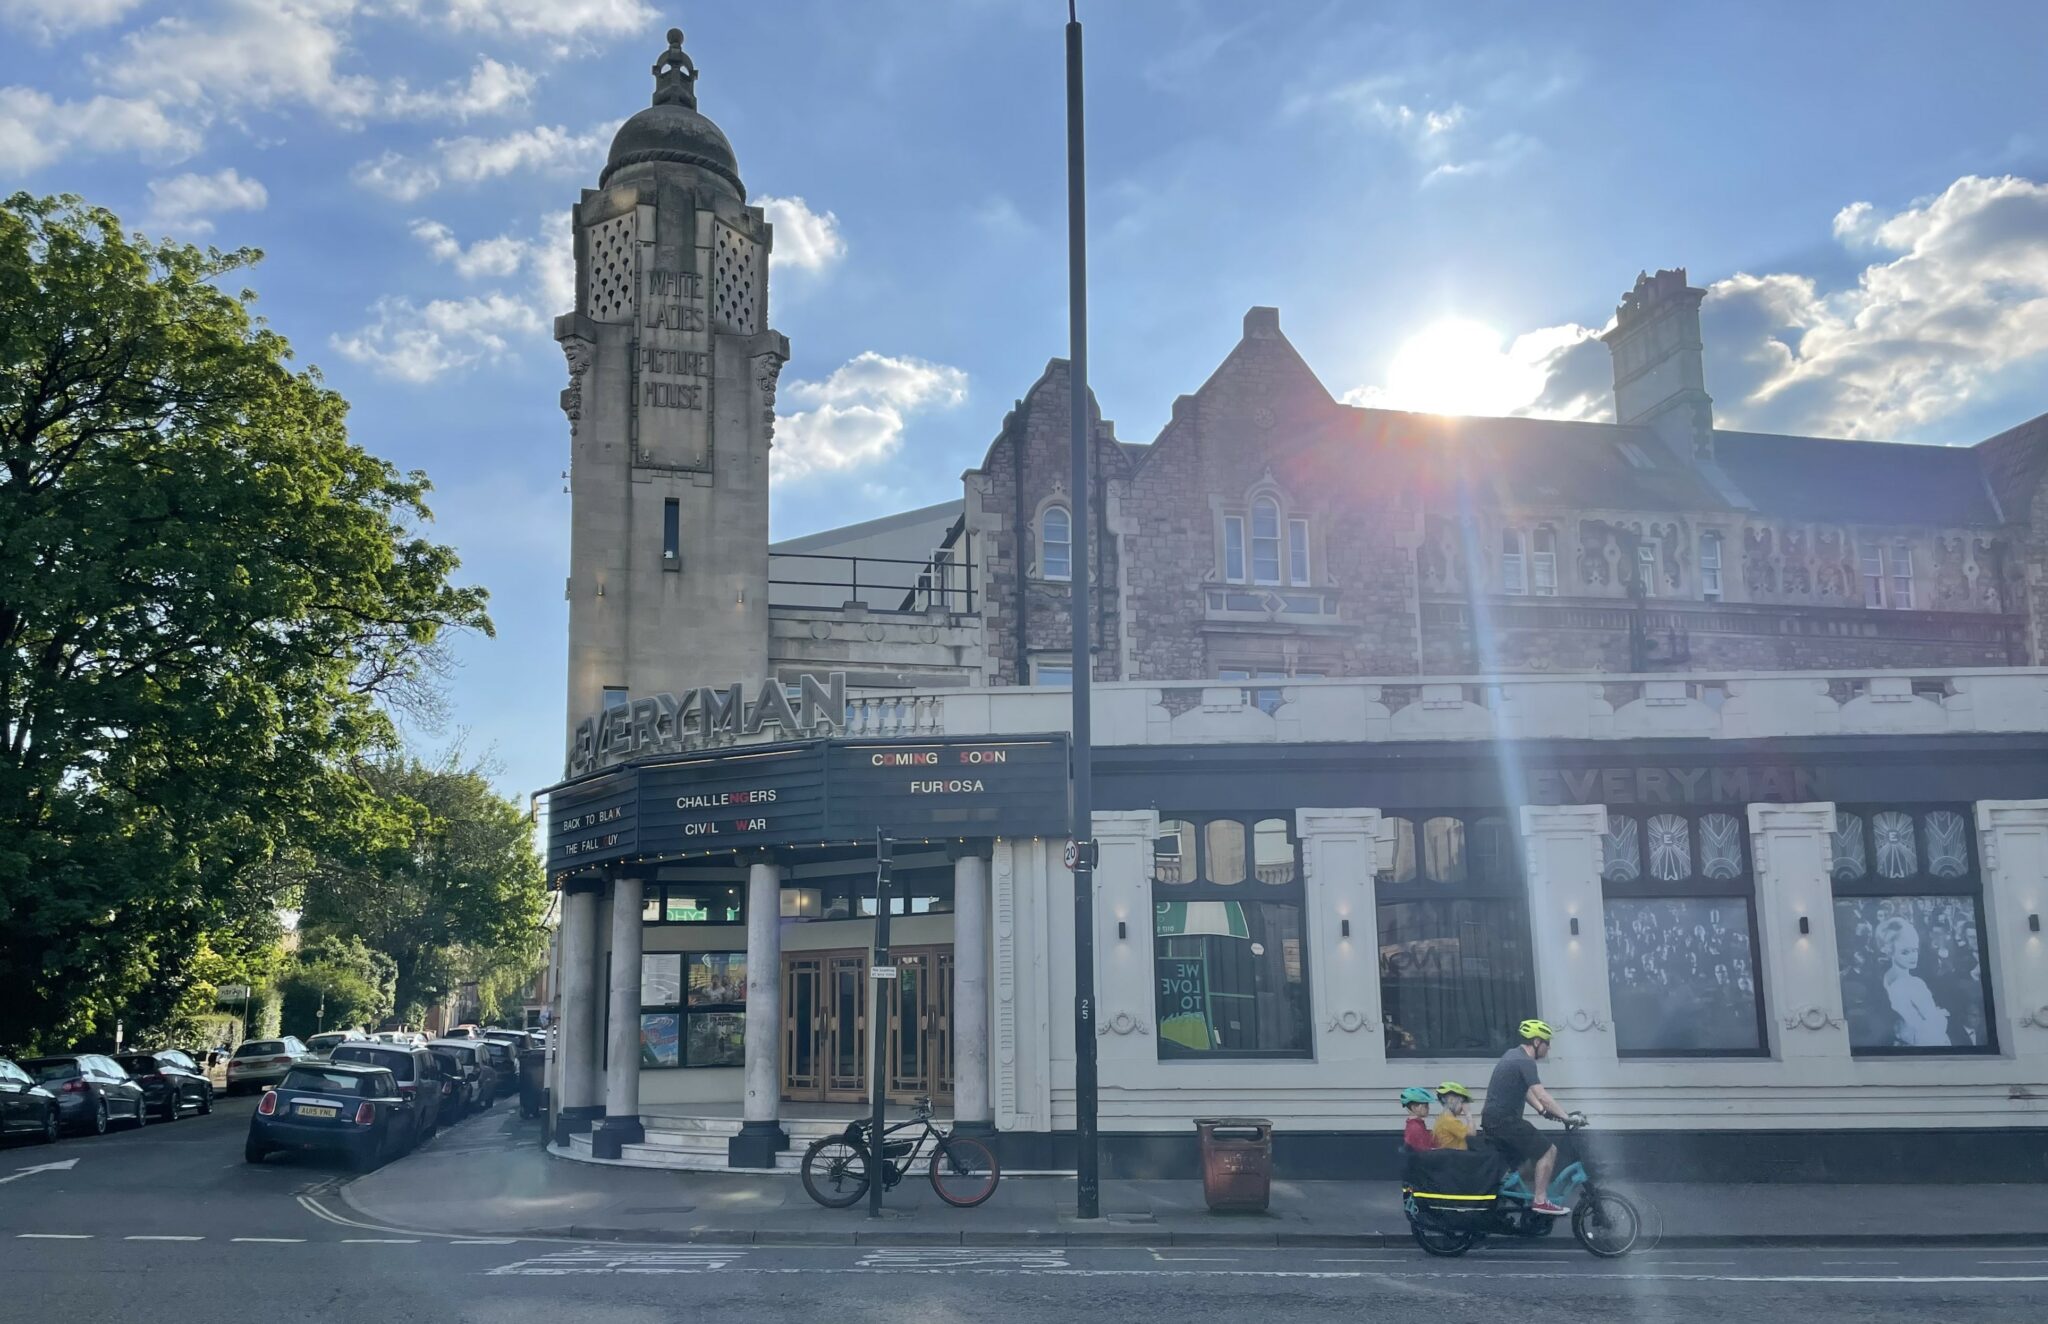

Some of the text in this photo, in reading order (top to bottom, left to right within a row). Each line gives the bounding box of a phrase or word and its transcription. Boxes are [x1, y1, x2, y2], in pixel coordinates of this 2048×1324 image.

[649, 272, 704, 299] WHITE
[645, 304, 704, 332] LADIES
[639, 348, 708, 377] PICTURE
[644, 382, 703, 410] HOUSE
[571, 671, 846, 772] EVERYMAN
[872, 750, 1006, 767] COMING SOON
[910, 780, 984, 793] FURIOSA
[1527, 765, 1826, 803] EVERYMAN
[676, 789, 777, 810] CHALLENGERS
[563, 818, 580, 831] BACK
[585, 813, 596, 826] TO
[684, 818, 766, 836] CIVIL WAR
[565, 843, 578, 855] THE
[582, 838, 599, 852] FALL
[1065, 847, 1075, 861] 20
